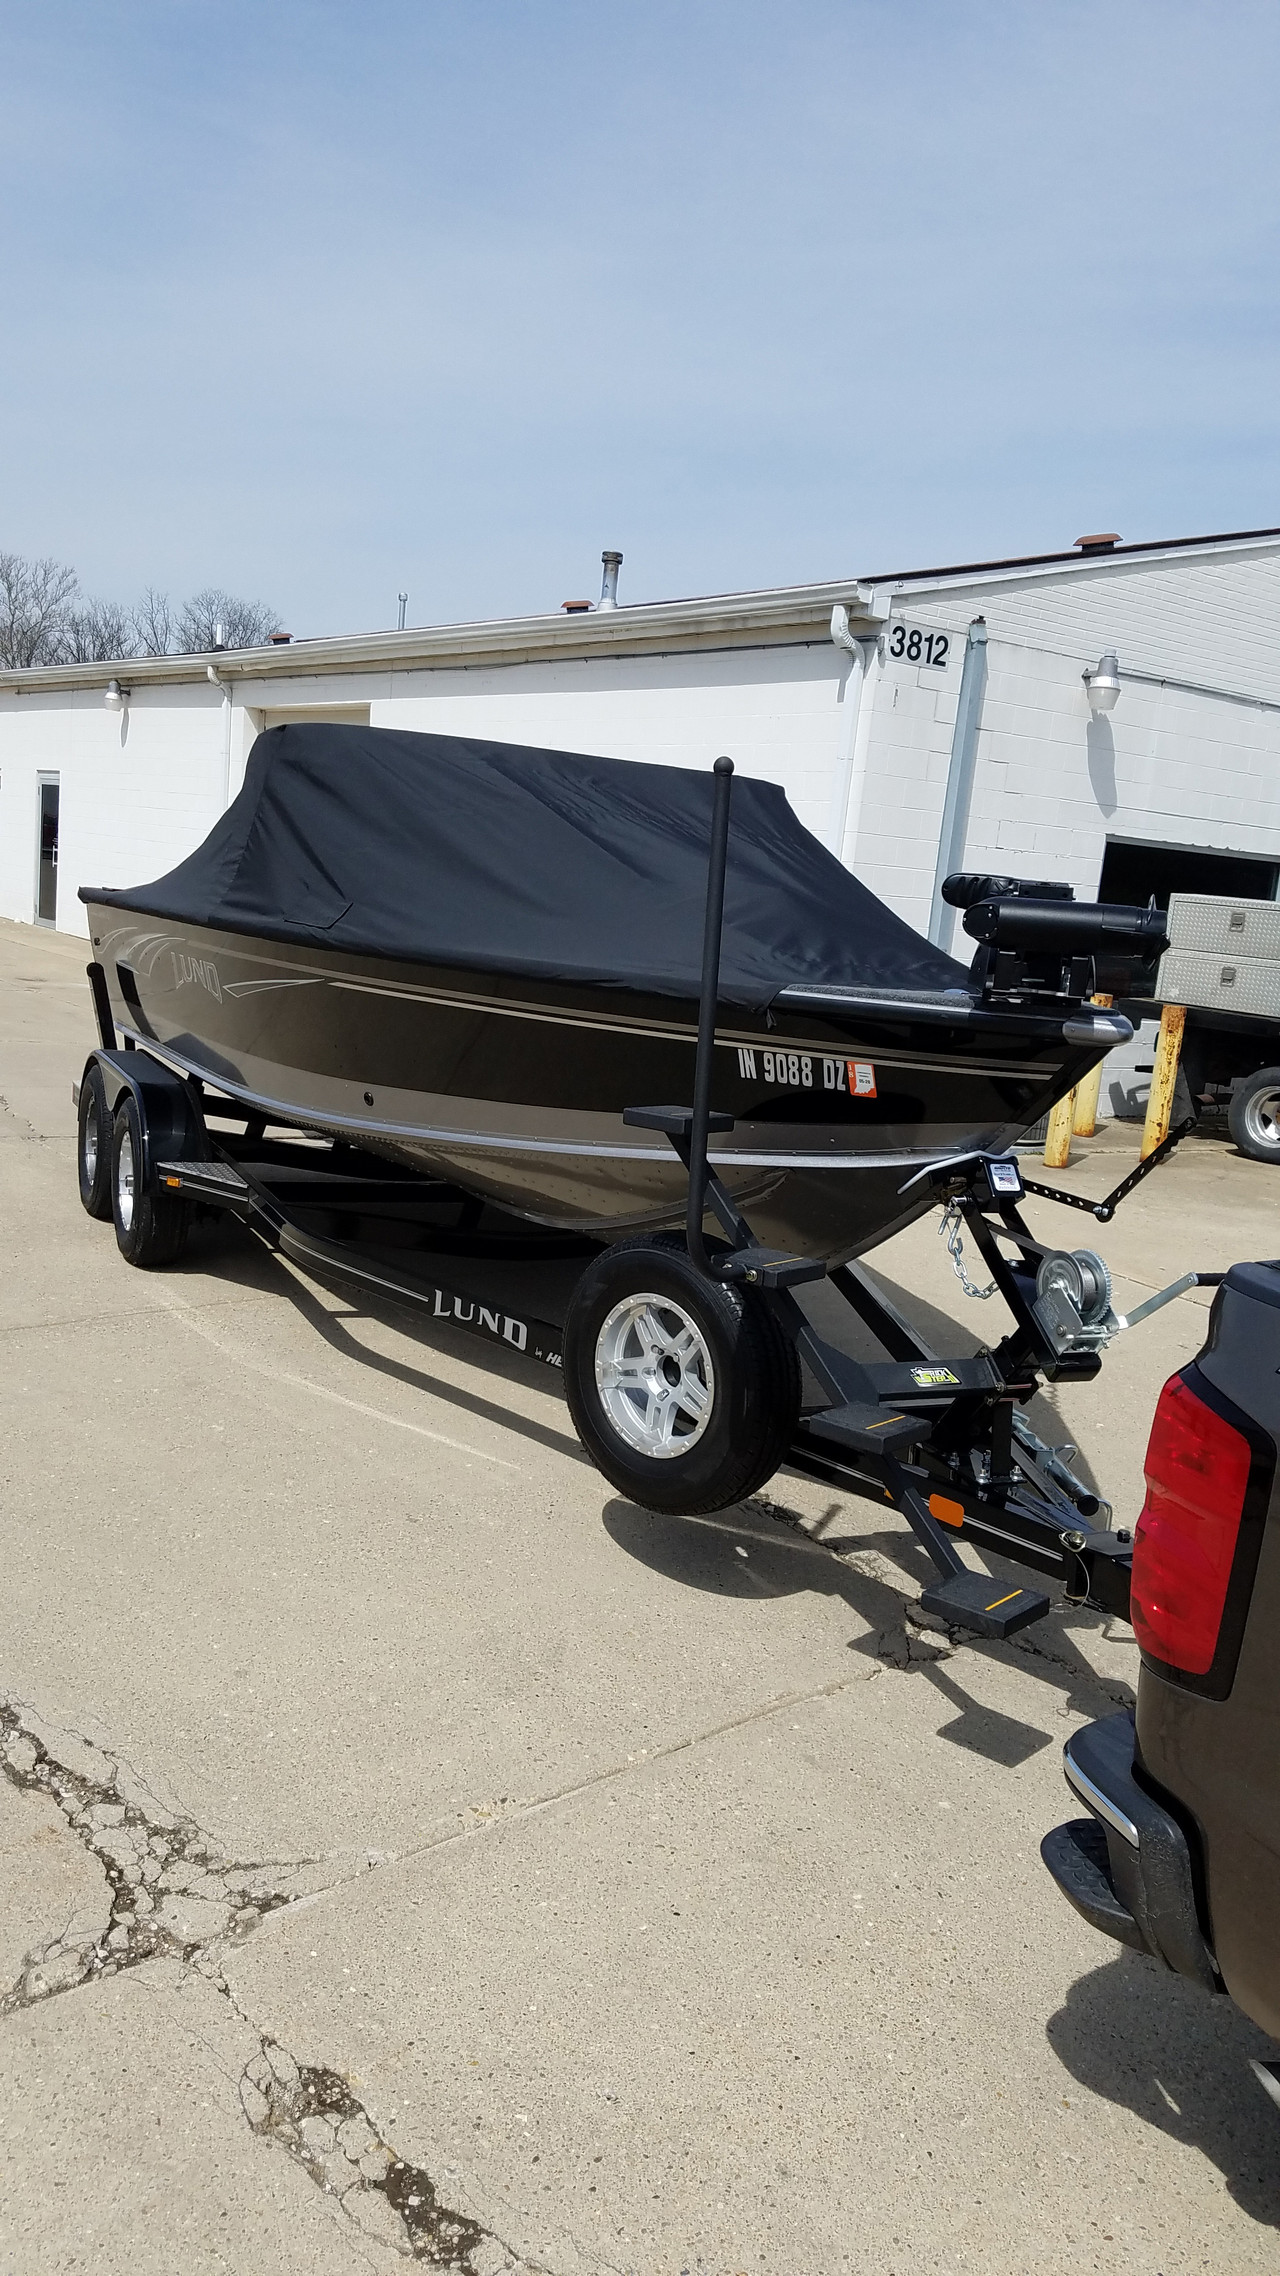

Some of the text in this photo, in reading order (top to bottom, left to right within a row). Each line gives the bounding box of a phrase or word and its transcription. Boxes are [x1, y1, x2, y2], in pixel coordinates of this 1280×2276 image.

[890, 625, 949, 667] 3812
[170, 951, 223, 1004] LUND
[737, 1048, 846, 1091] IN 9088 DZ
[433, 1289, 528, 1351] LUND
